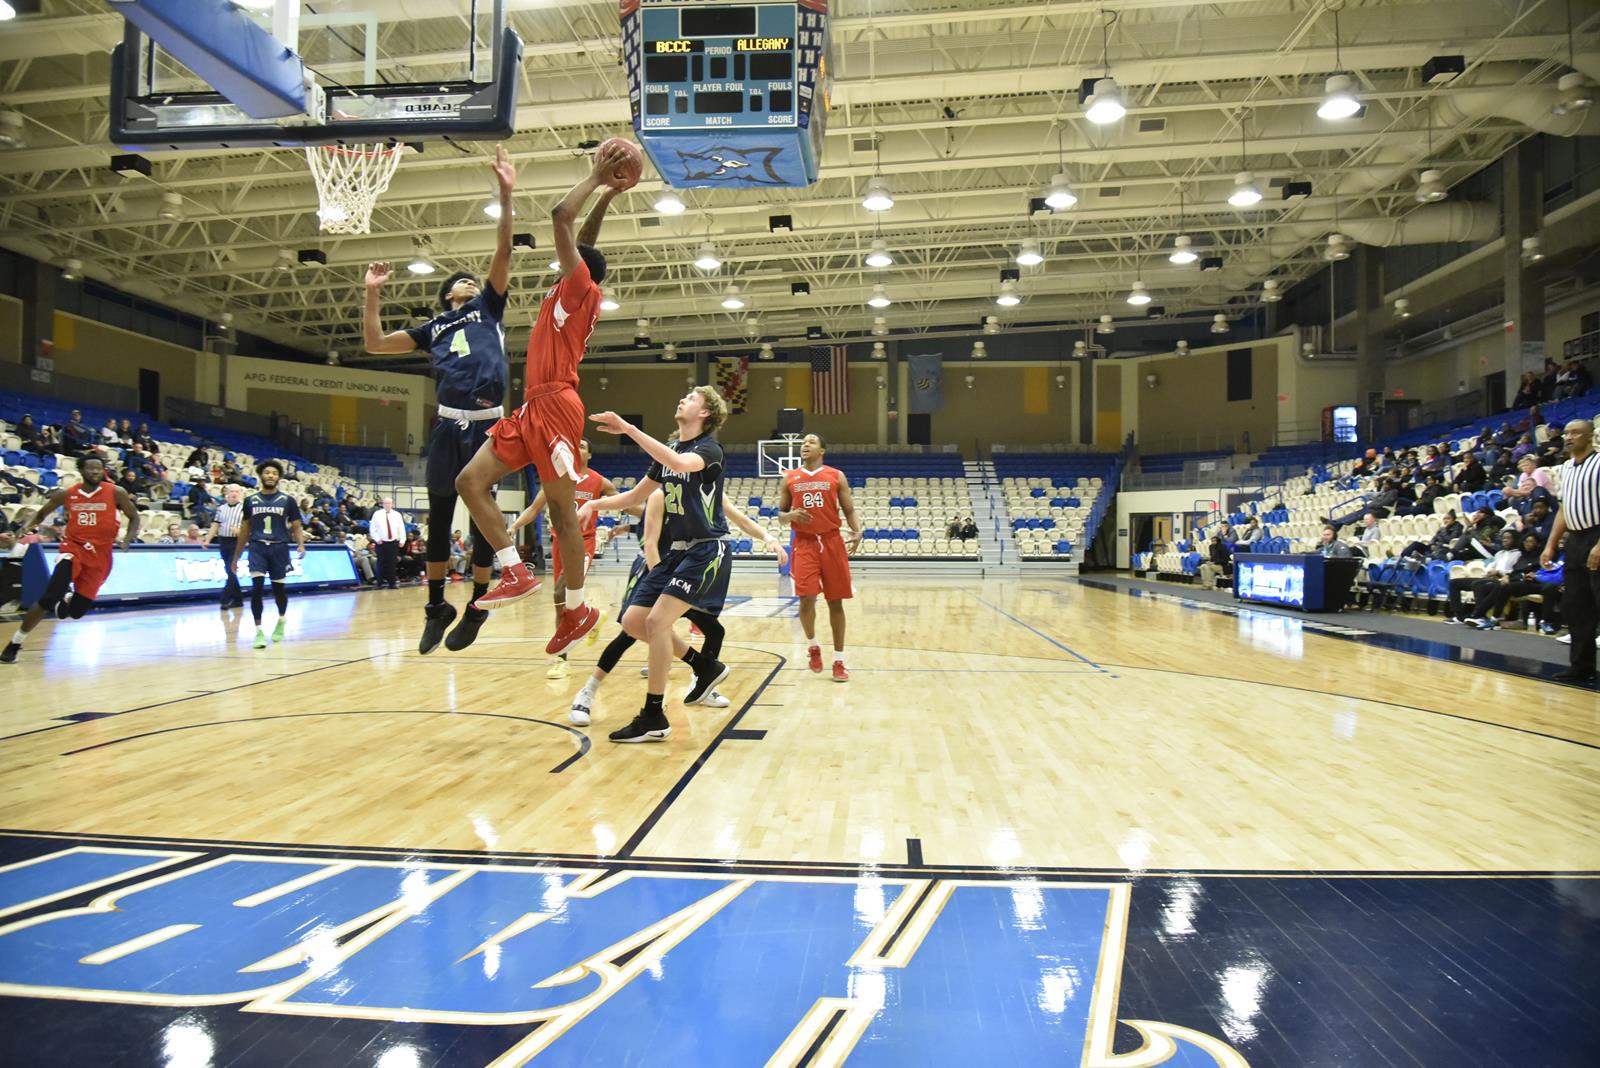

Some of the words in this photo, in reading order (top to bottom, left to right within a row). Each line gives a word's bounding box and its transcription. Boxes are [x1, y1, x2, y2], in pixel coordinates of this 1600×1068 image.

[656, 40, 691, 53] BCCC
[705, 46, 732, 55] PERIOD
[737, 38, 789, 51] ALLEGANY
[645, 85, 669, 93] FOULS
[693, 83, 722, 92] PLAYER
[725, 83, 745, 91] FOUL
[768, 82, 793, 90] FOULS
[646, 117, 670, 126] SCORE
[705, 116, 732, 125] MATCH
[768, 115, 793, 124] SCORE
[449, 328, 471, 358] 4
[244, 372, 266, 382] APG
[270, 375, 309, 386] FEDERAL
[312, 378, 343, 389] CREDIT
[346, 381, 378, 392] UNION
[380, 385, 410, 396] ARENA
[665, 482, 685, 515] 21
[803, 491, 824, 509] 24
[252, 506, 285, 516] ALLEGANY
[78, 512, 96, 526] 21
[263, 515, 272, 534] 1
[668, 577, 692, 594] ACM
